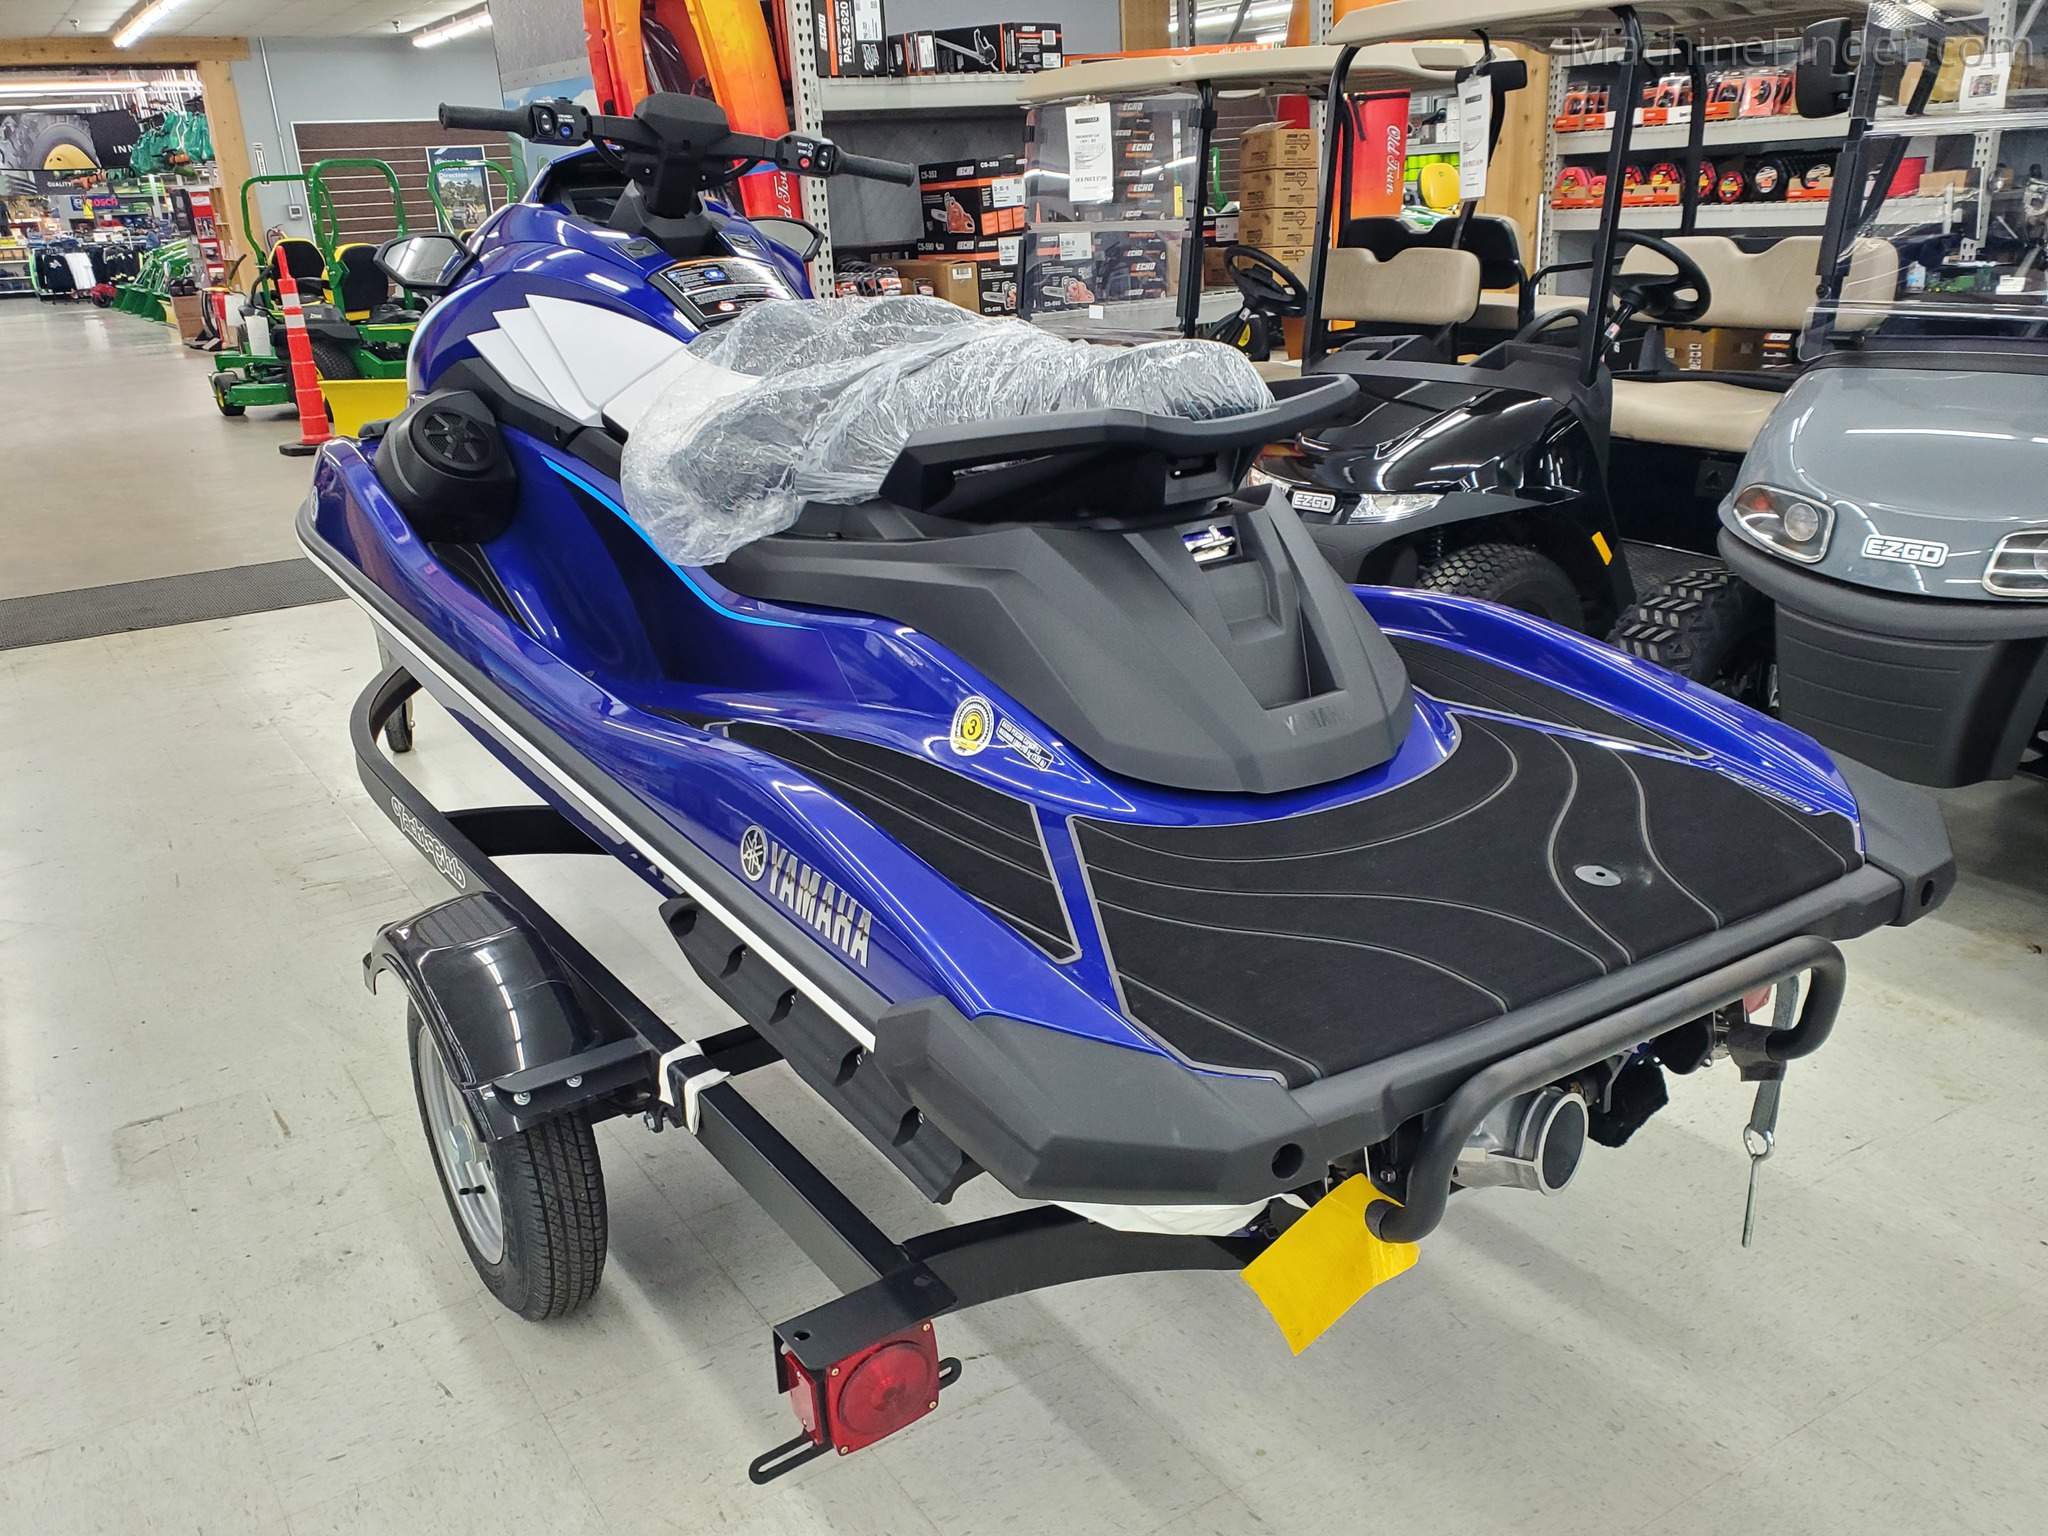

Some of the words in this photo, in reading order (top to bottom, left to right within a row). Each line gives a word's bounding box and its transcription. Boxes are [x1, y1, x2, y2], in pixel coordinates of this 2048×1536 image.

[818, 13, 828, 48] ECHO
[840, 1, 853, 63] PAS-2620
[1123, 103, 1143, 111] ECHO
[1132, 143, 1153, 151] ECHO
[1387, 125, 1401, 155] Old
[1386, 155, 1400, 195] Town
[91, 198, 119, 206] OSCH
[1136, 262, 1156, 270] ECHO
[967, 719, 978, 736] 3
[769, 841, 873, 968] YAMAHA
